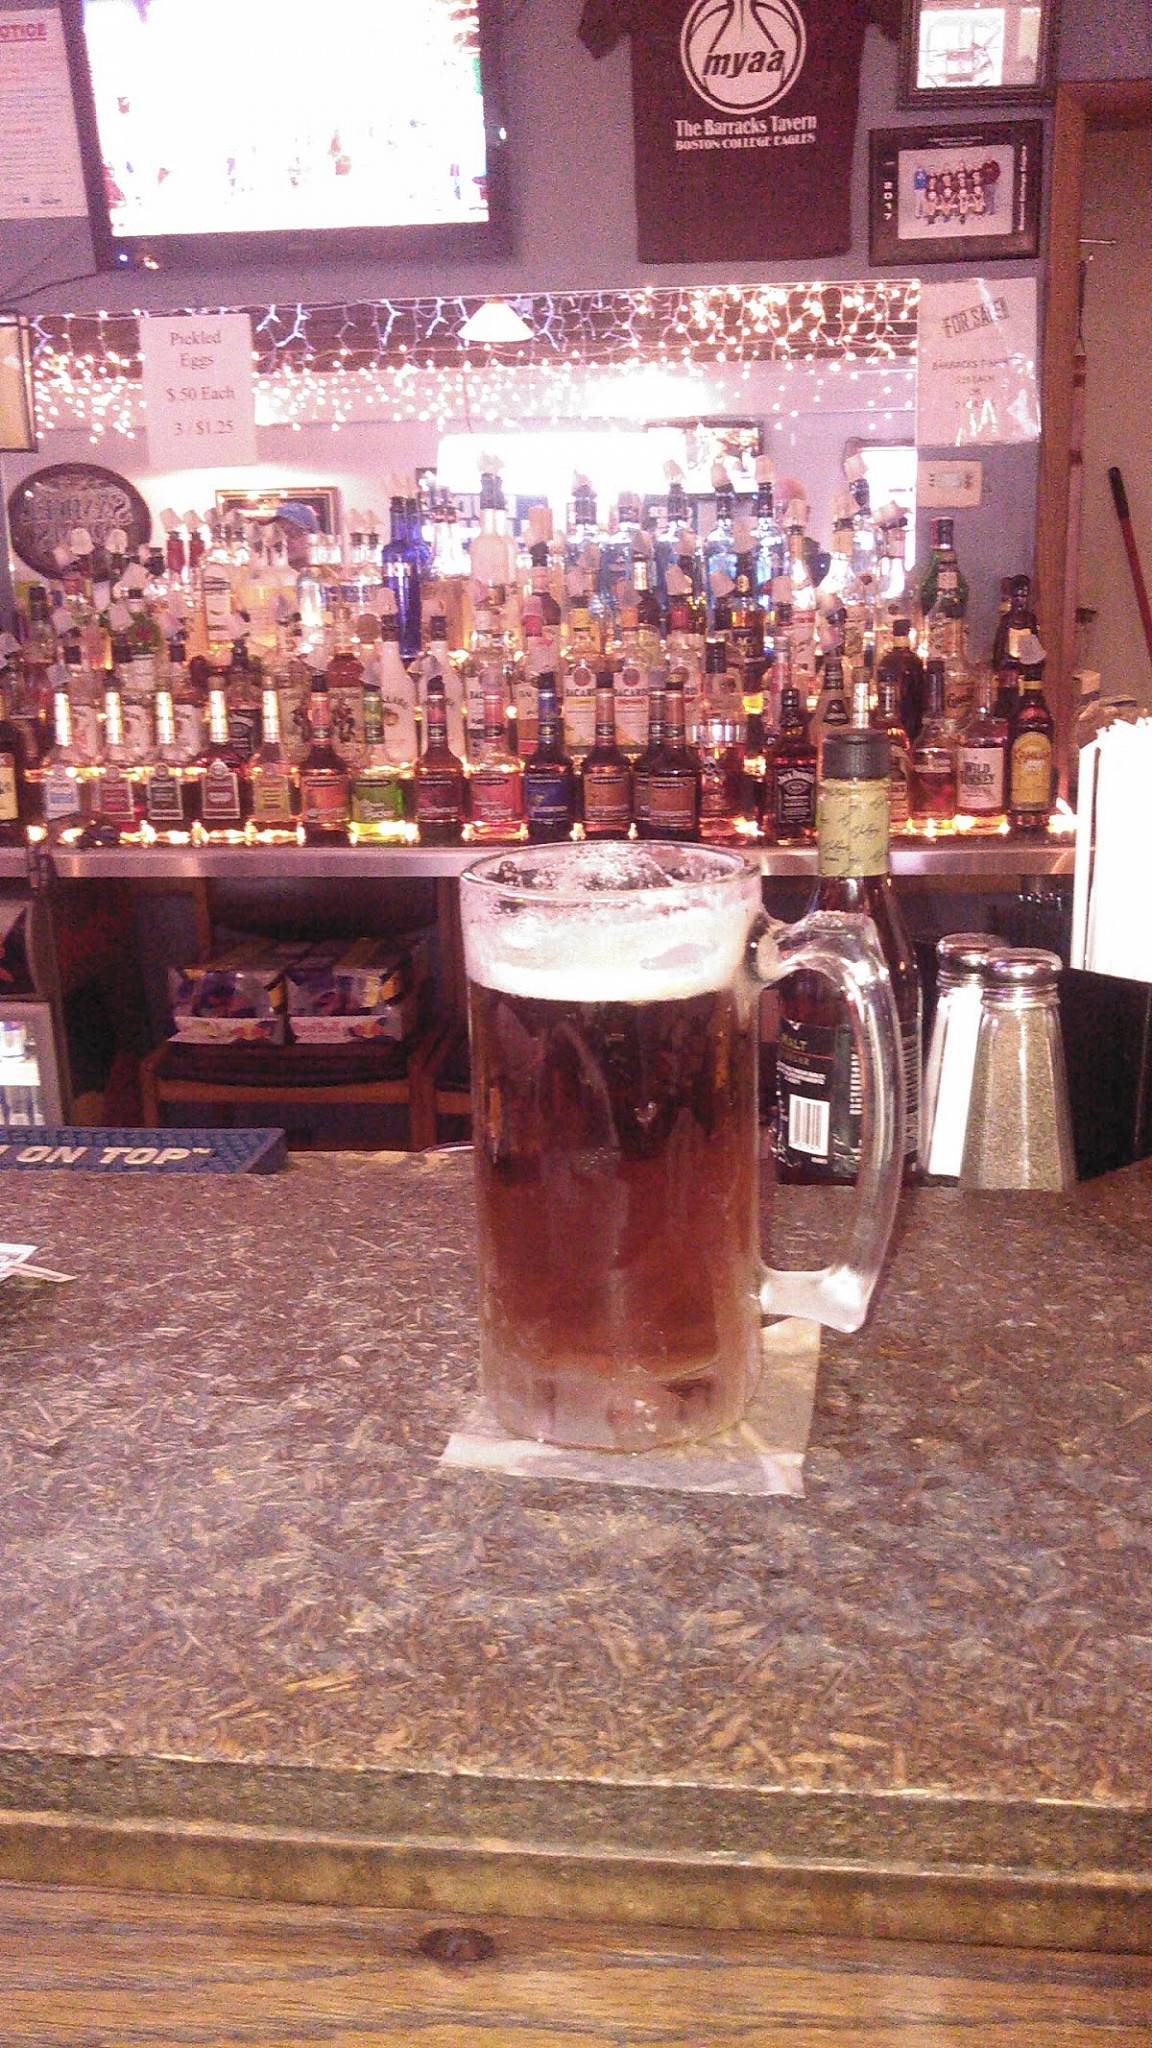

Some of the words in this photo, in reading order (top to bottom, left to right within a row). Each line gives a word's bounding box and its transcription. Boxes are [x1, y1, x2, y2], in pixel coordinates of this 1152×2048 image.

[702, 49, 786, 78] myaa
[674, 119, 701, 137] The
[703, 117, 768, 136] Barracks
[769, 115, 817, 133] Tavern
[675, 139, 720, 151] BOSTON
[721, 136, 772, 149] COLLEGE
[170, 330, 222, 346] Pickled
[180, 353, 214, 371] Eggs
[201, 385, 236, 401] Each
[16, 1146, 88, 1164] ON
